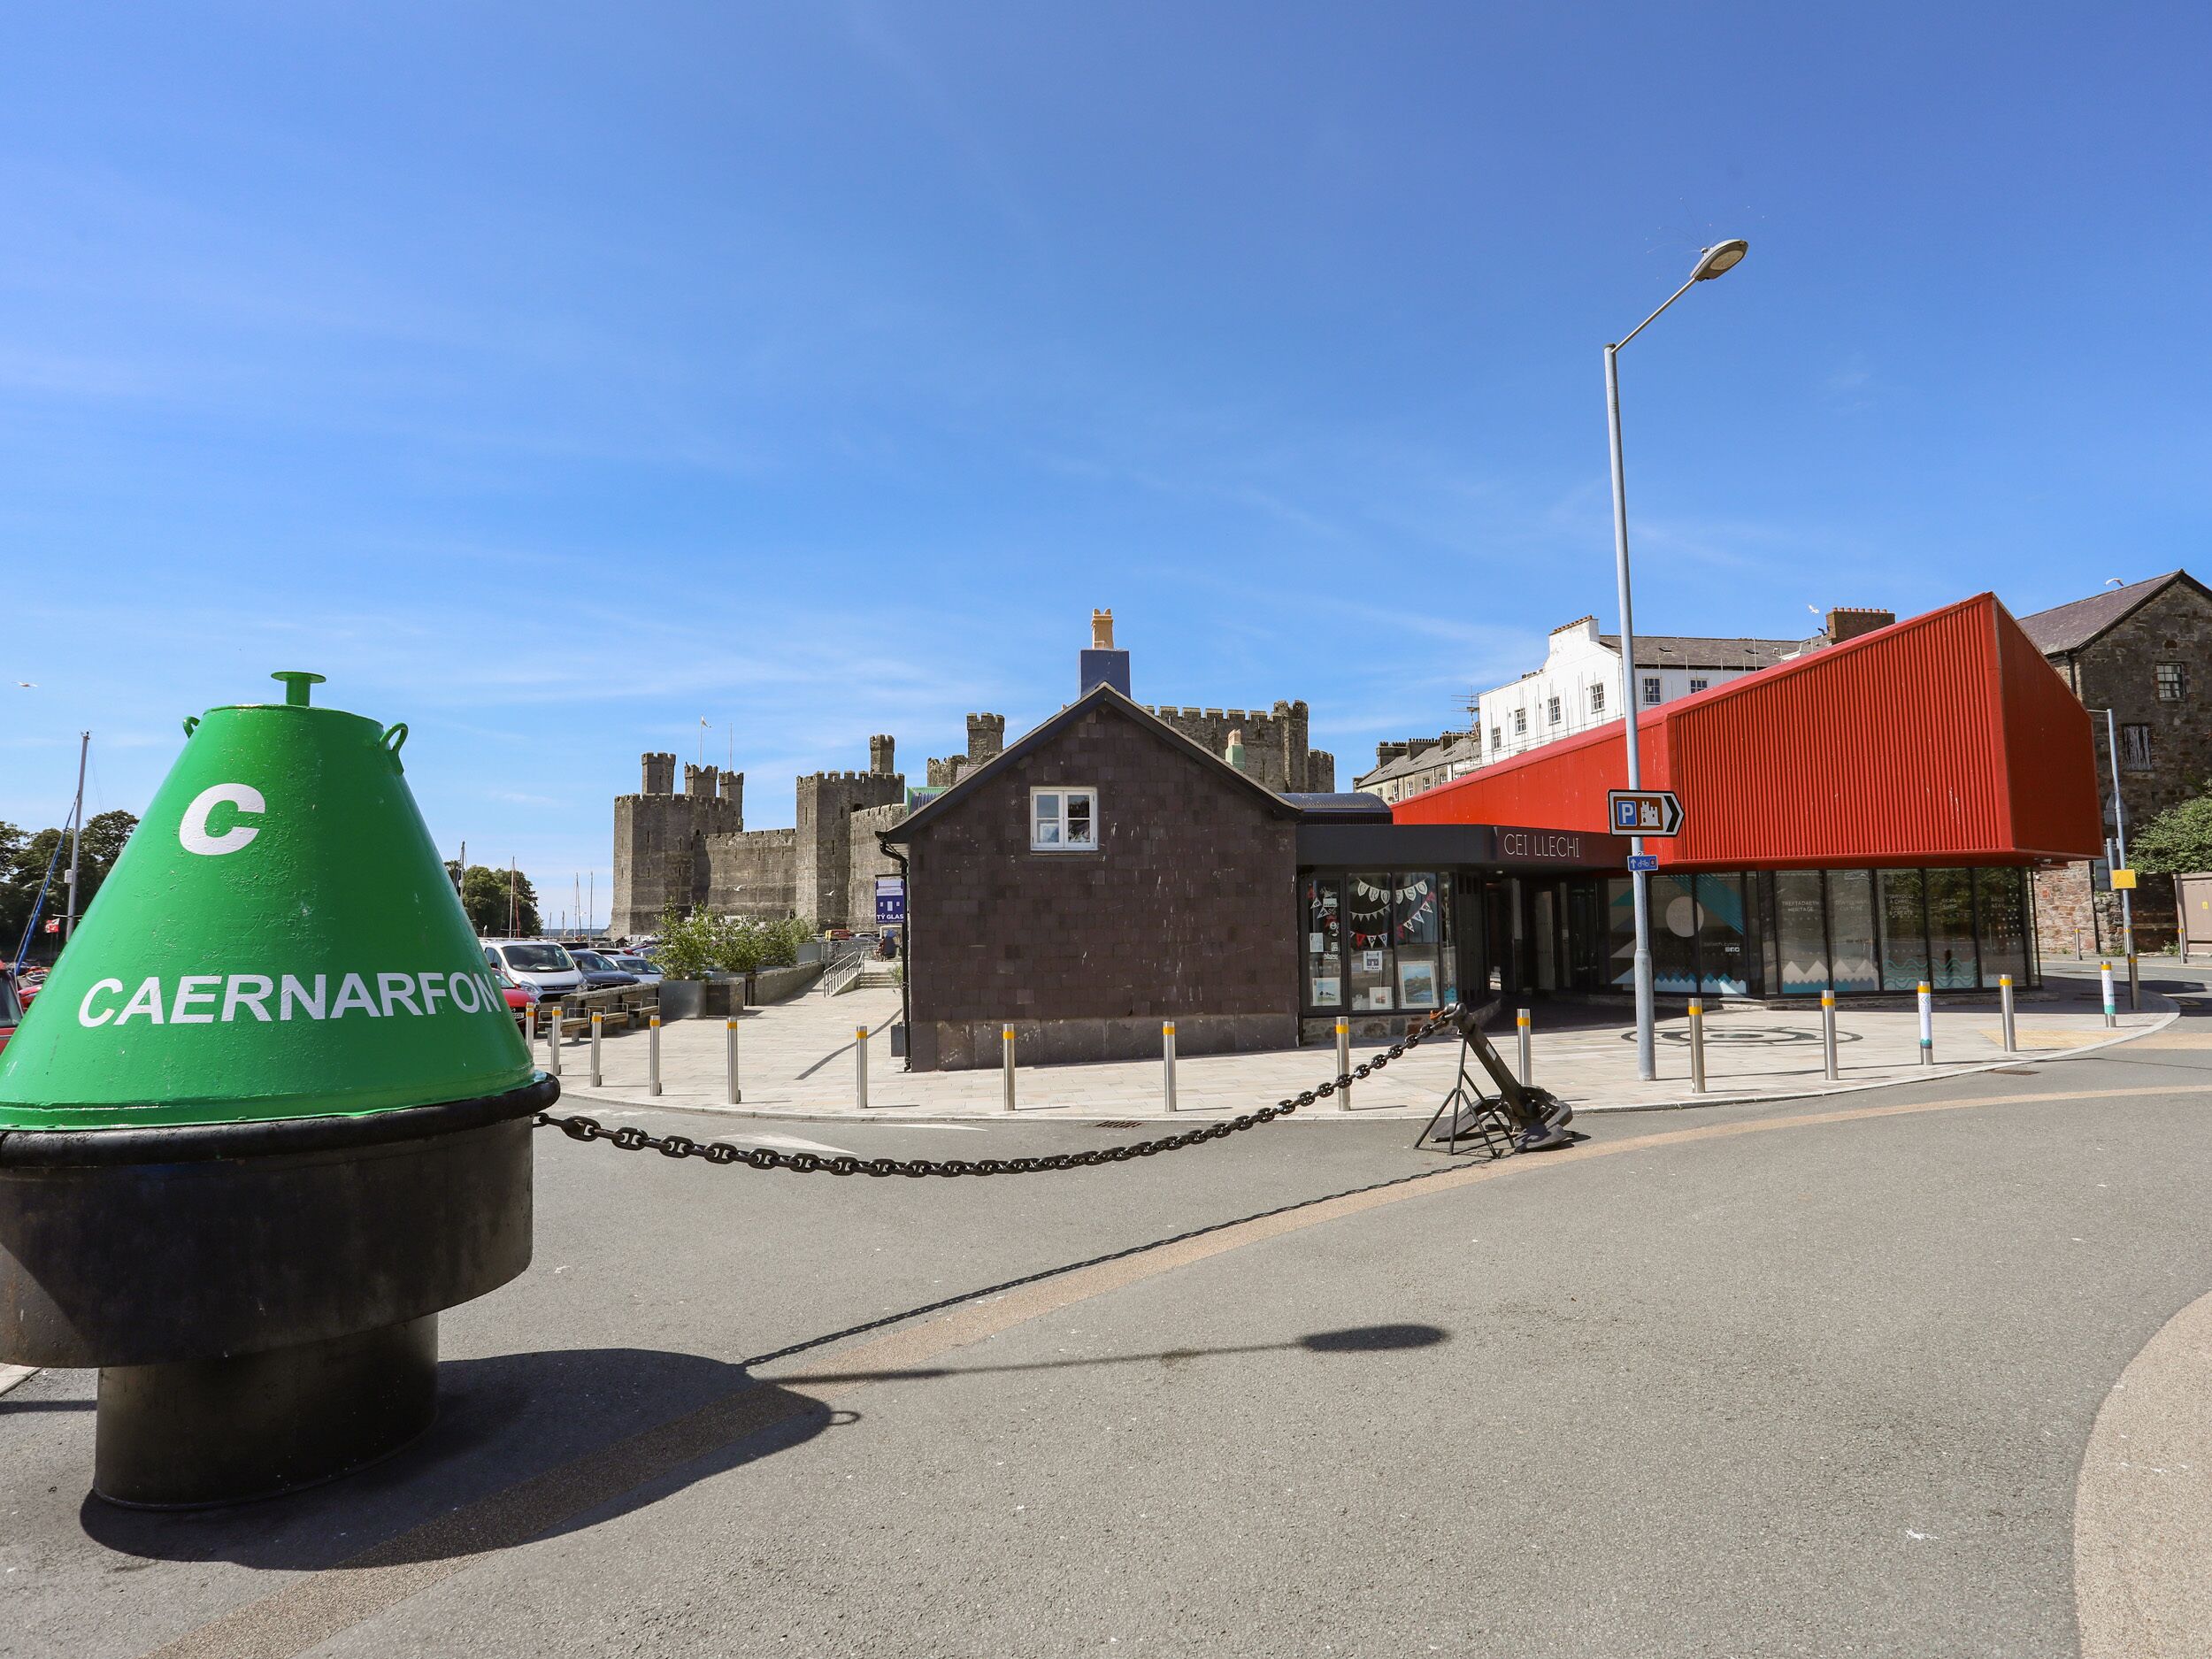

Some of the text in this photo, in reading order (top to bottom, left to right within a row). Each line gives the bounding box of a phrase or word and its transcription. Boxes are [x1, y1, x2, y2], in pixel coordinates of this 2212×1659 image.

[179, 783, 266, 856] C
[1621, 803, 1634, 824] P
[1504, 833, 1581, 858] CEI LLECHI
[79, 972, 501, 1028] CAERNARFON
